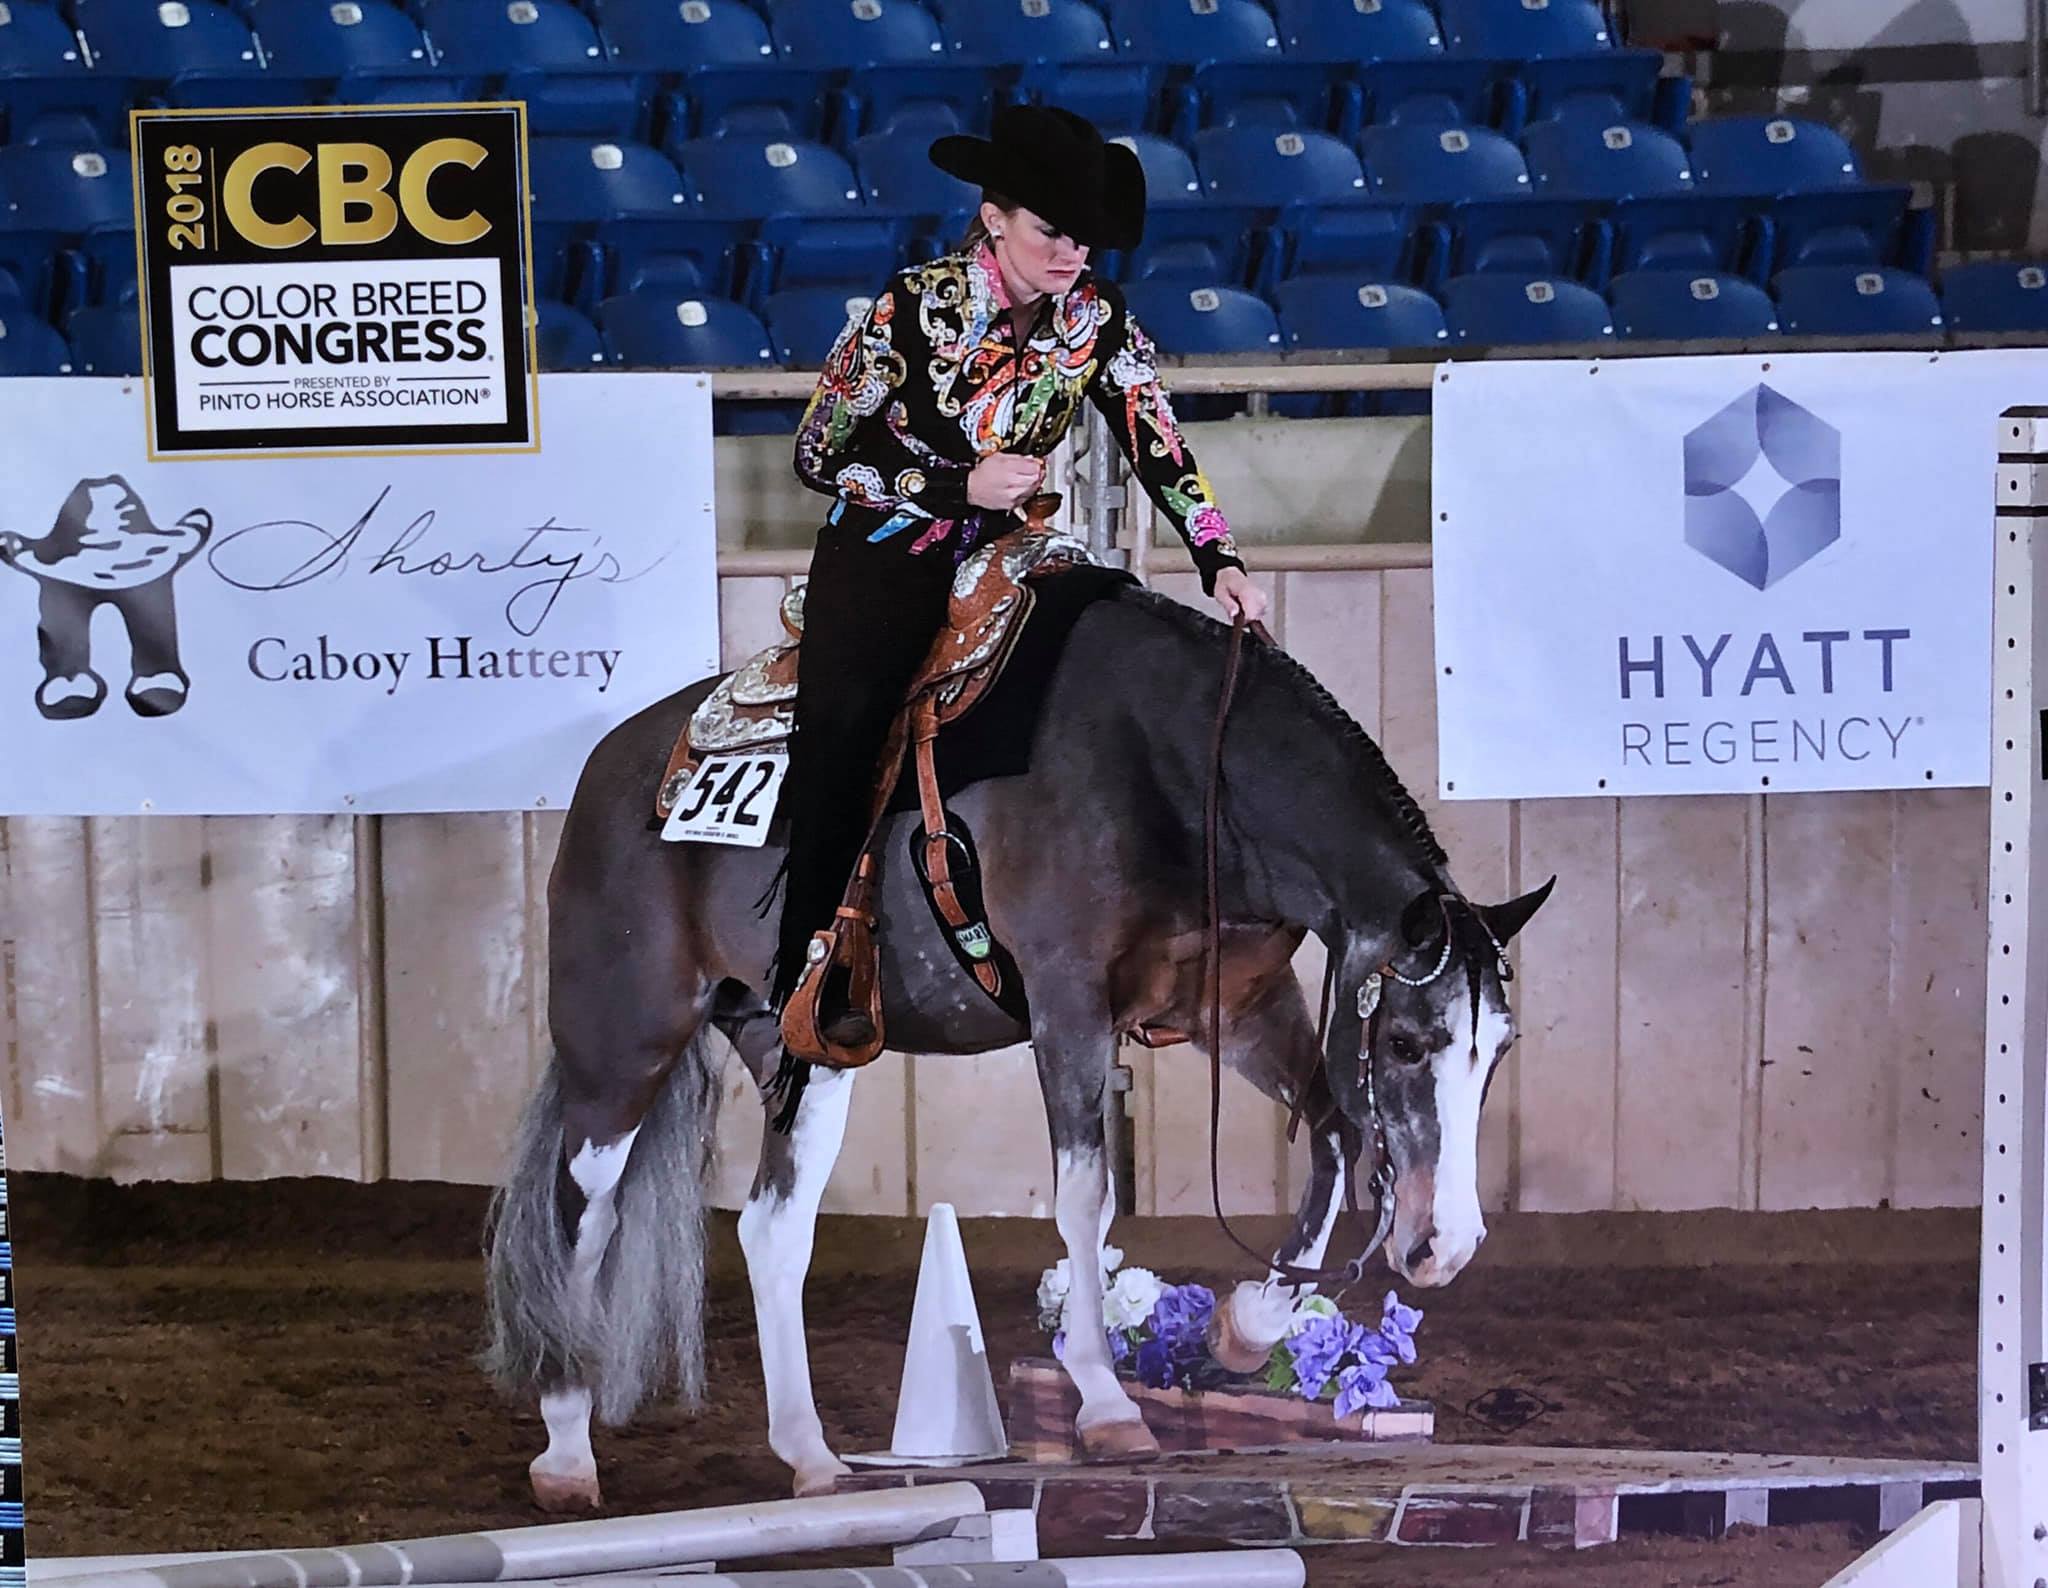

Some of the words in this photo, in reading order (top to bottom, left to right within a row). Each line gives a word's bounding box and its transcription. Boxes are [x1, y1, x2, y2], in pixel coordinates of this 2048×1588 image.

[208, 485, 680, 636] Shorty's
[247, 635, 412, 695] Caboy
[424, 635, 624, 693] Hattery
[1618, 628, 1911, 699] HYATT
[678, 760, 776, 826] 542
